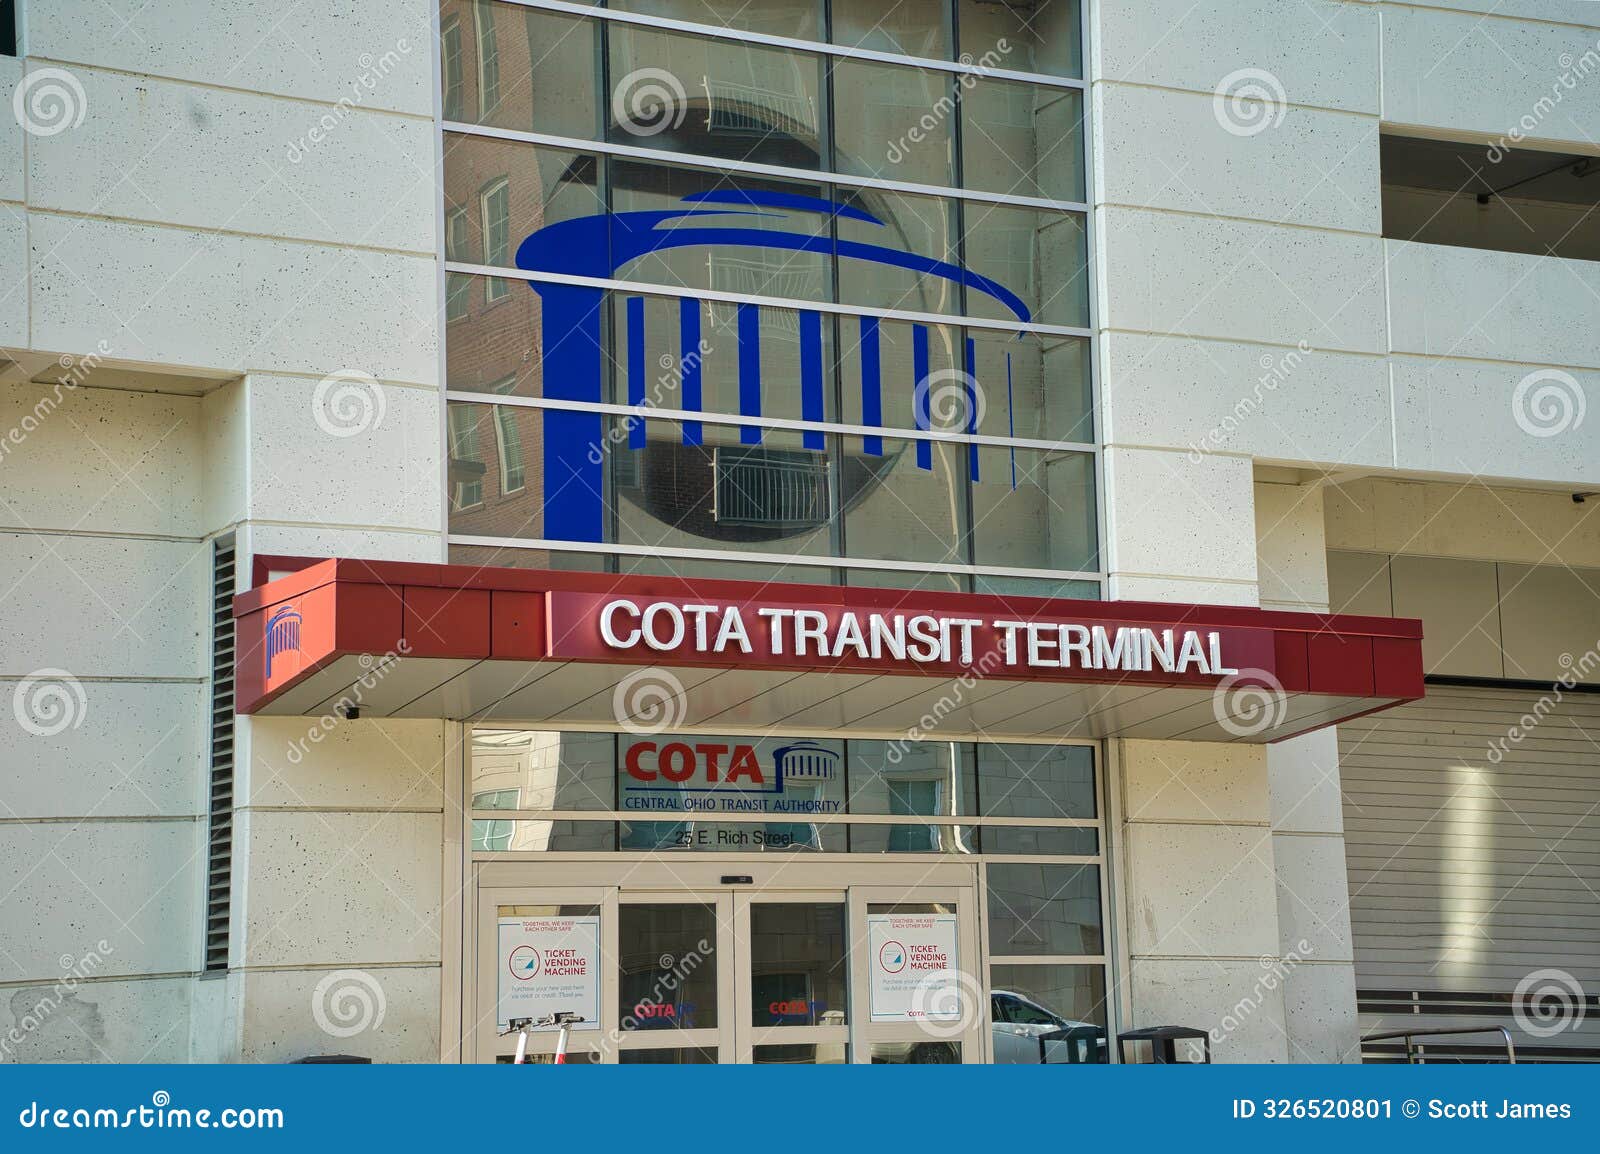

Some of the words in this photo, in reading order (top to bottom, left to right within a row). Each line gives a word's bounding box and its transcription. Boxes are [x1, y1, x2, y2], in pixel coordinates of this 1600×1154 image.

[600, 599, 753, 653] COTA
[758, 608, 982, 664] TRANSIT
[993, 619, 1238, 675] TERMINAL
[625, 741, 765, 784] COTA
[625, 797, 681, 811] CENTRAL
[684, 798, 716, 811] OHIO
[721, 799, 769, 811] TRANSIT
[773, 799, 840, 812] AUTHORITY
[675, 831, 693, 845] 25
[699, 831, 713, 845] E.
[718, 830, 749, 845] Rich
[753, 831, 795, 845] Street
[544, 949, 577, 958] TICKET
[910, 945, 938, 953] TICKET
[544, 958, 586, 967] VENDING
[910, 953, 947, 961] VENDING
[544, 967, 586, 976] MACHINE
[910, 962, 947, 970] MACHINE
[634, 1003, 676, 1018] COTA
[769, 1000, 809, 1016] COTA
